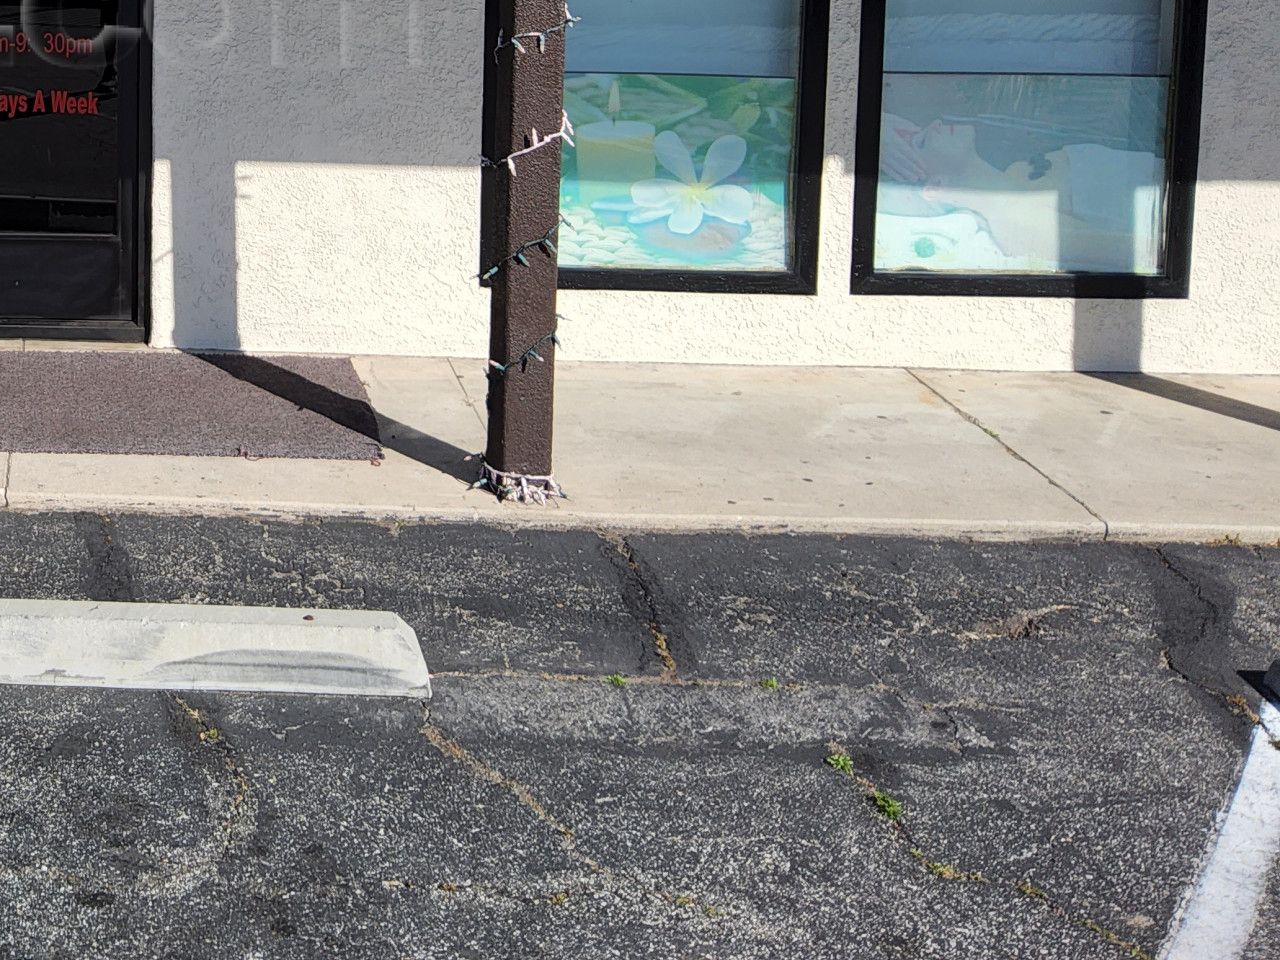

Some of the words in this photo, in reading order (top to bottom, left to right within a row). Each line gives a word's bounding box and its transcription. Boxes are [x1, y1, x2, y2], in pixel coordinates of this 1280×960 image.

[43, 32, 94, 58] 30pm
[32, 89, 45, 113] A
[51, 90, 99, 115] Week
